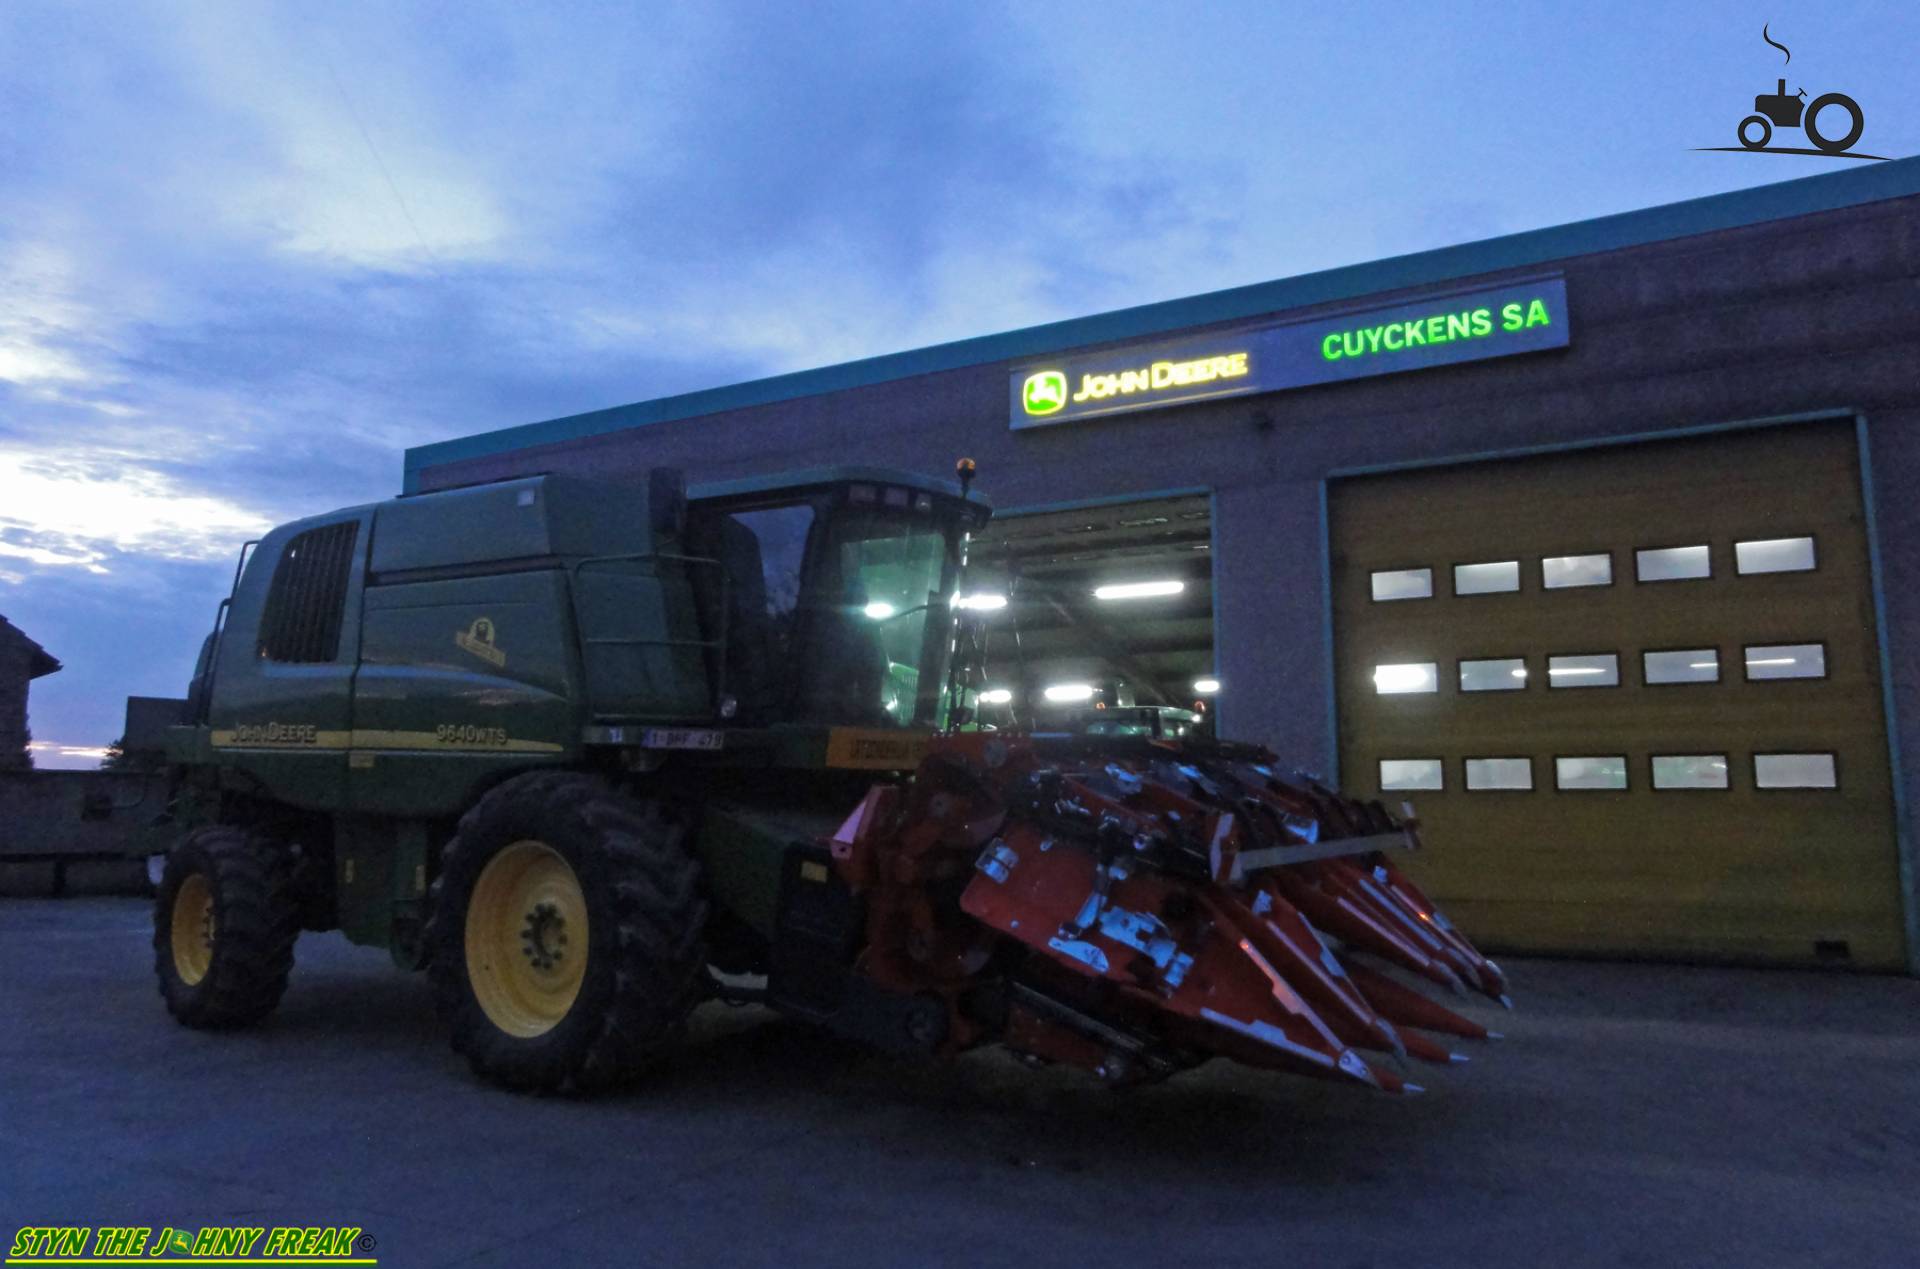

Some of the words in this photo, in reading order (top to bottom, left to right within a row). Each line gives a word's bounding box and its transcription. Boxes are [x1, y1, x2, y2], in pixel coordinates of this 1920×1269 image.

[1321, 308, 1493, 363] CUYCKENS
[1502, 299, 1551, 332] SA
[1072, 370, 1150, 403] JOHN
[1150, 352, 1249, 389] DEERE
[231, 722, 268, 743] JOHN
[267, 721, 318, 743] DEERE
